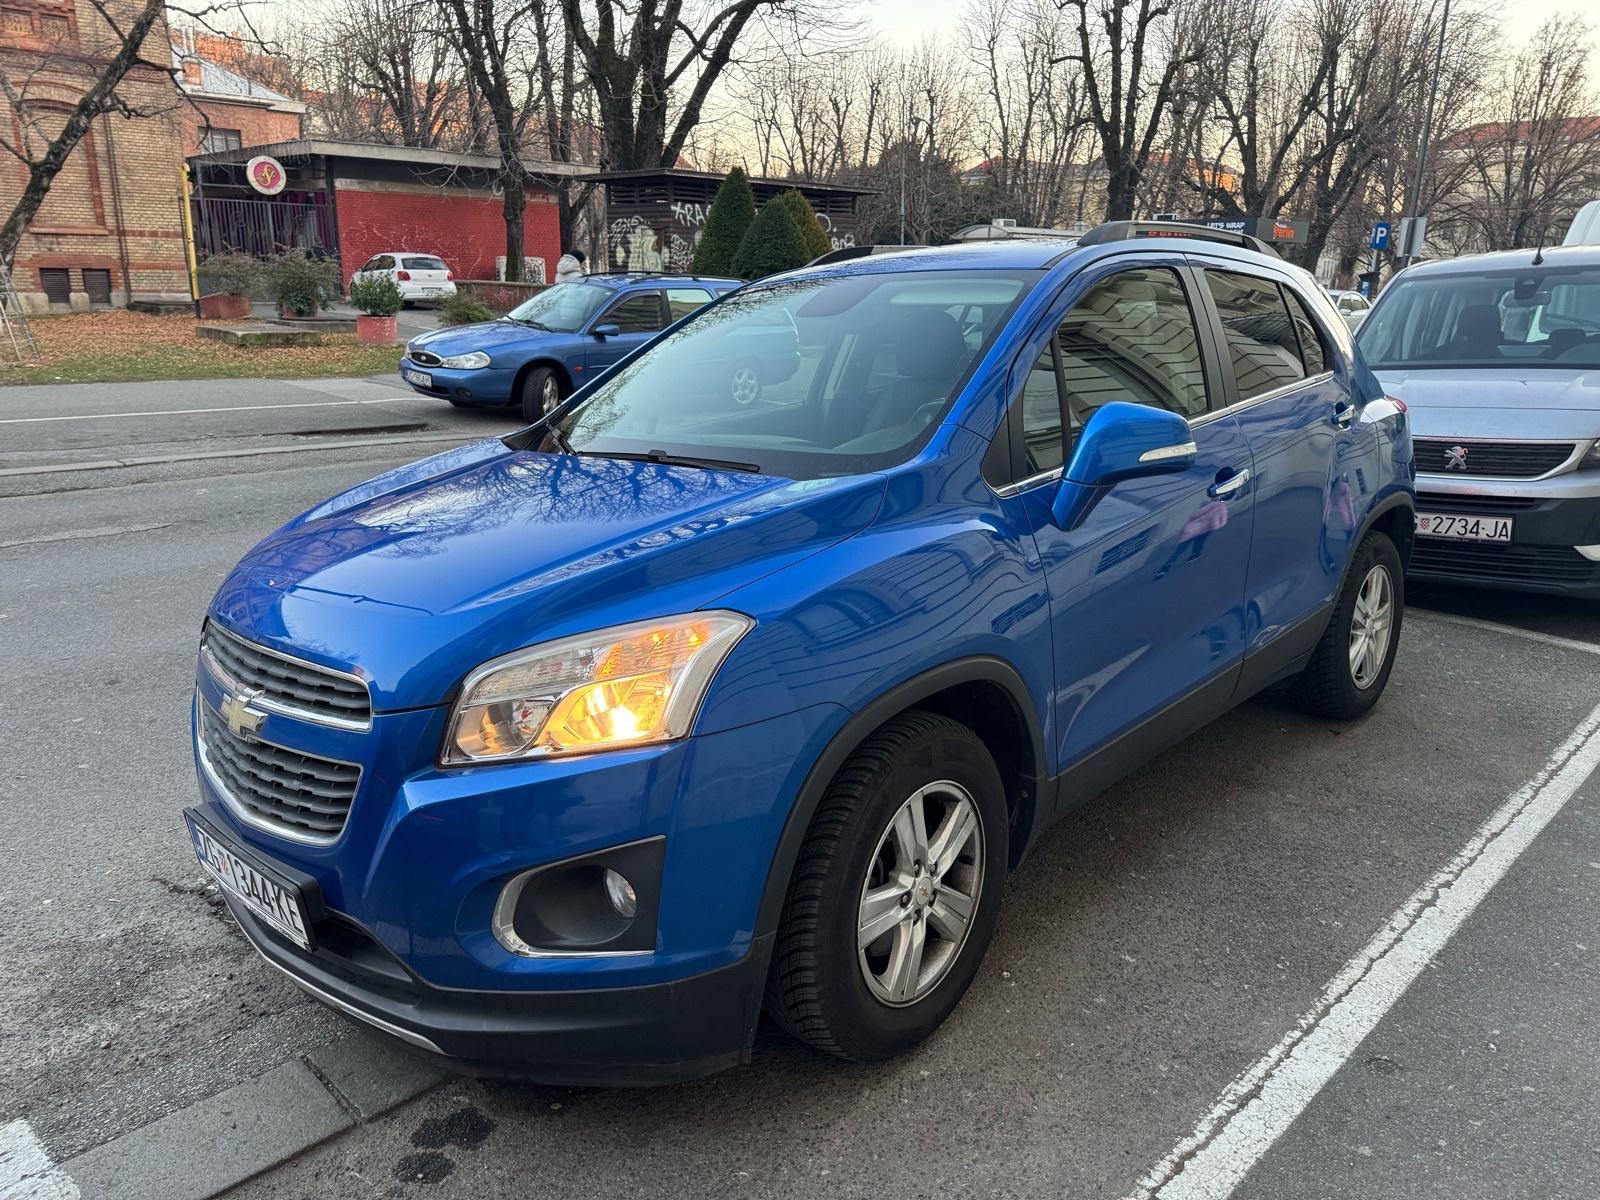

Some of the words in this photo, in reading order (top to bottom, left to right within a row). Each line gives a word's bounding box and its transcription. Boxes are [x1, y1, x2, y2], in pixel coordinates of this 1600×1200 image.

[1226, 221, 1246, 230] WRAP
[1375, 226, 1388, 244] P
[1432, 516, 1509, 539] 2734-JA
[226, 852, 303, 934] 1344-KE
